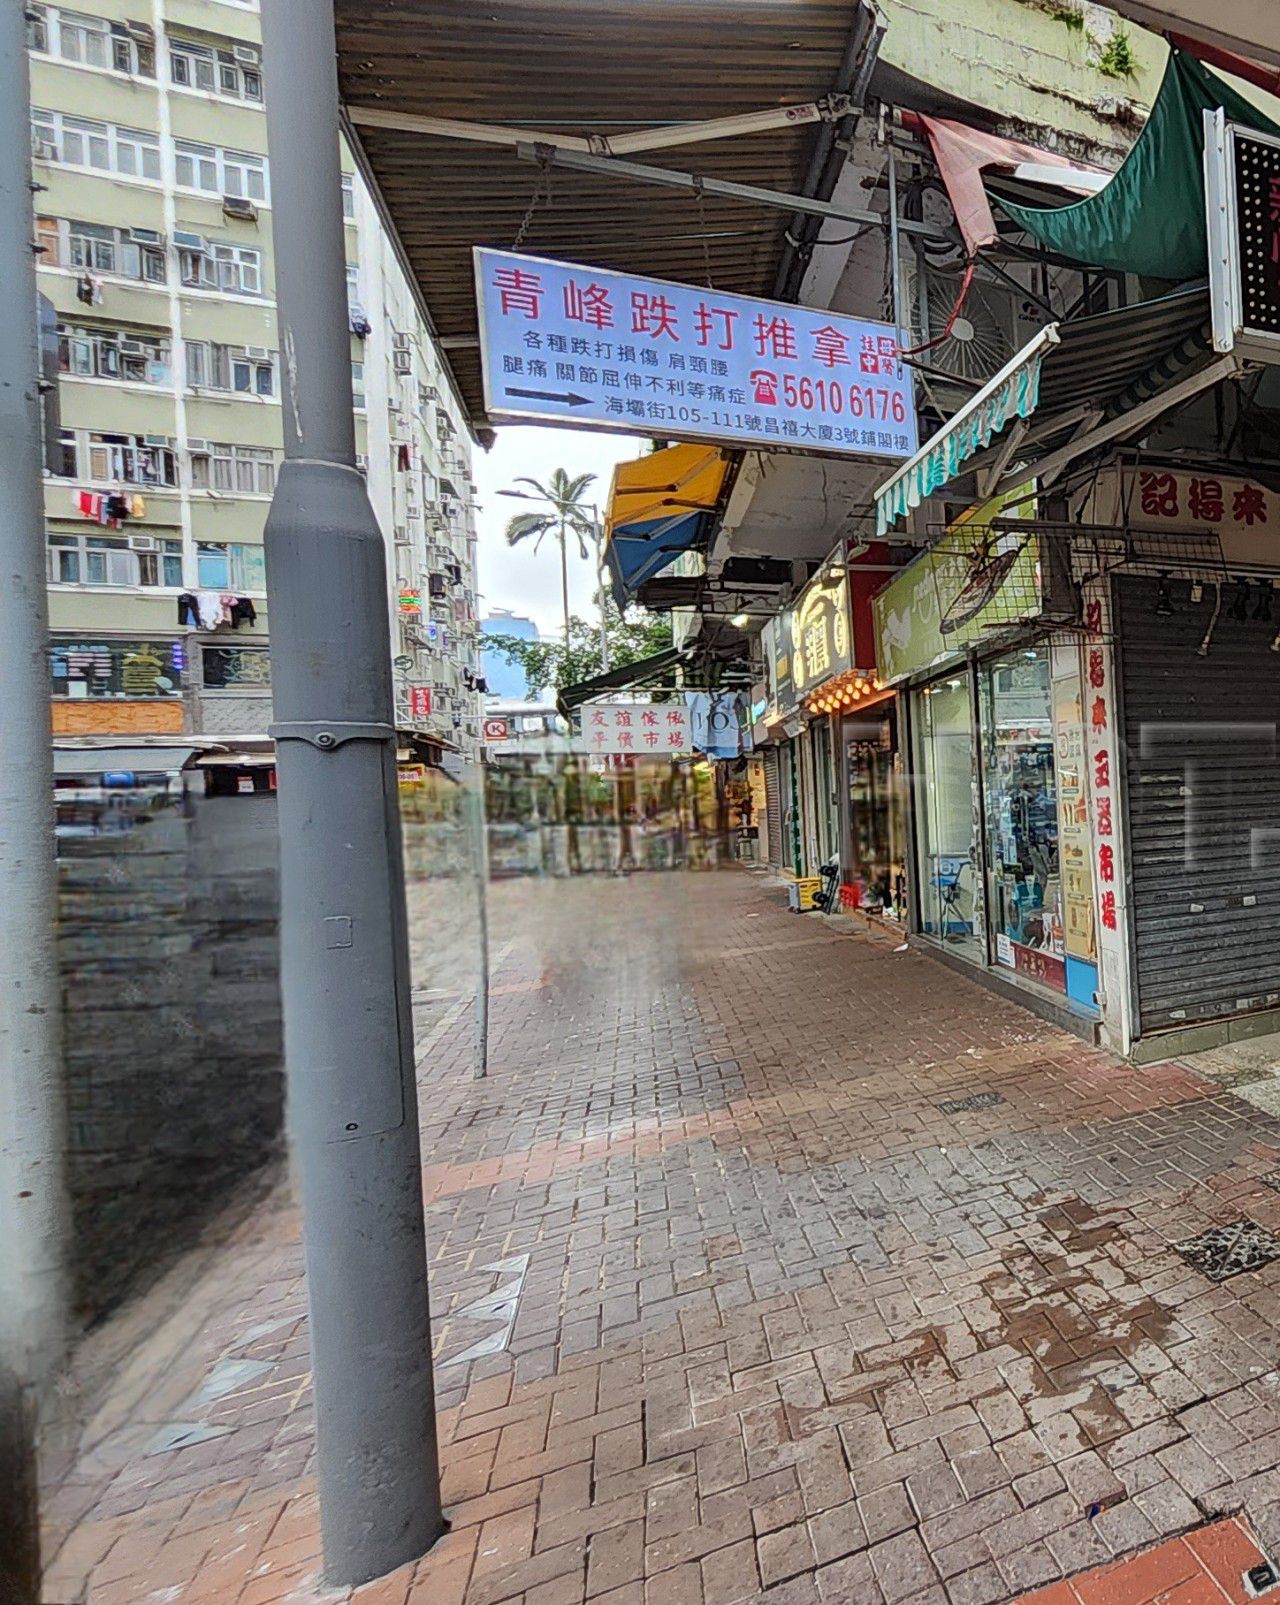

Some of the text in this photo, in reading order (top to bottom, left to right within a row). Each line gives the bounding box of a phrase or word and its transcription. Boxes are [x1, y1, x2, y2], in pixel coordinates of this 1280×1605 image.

[492, 268, 851, 369] 青峰跌打推拿
[523, 331, 659, 366] 各種跌打損傷
[556, 362, 747, 405] 關節屈伸不利等痛症
[783, 374, 906, 423] 5610 6176
